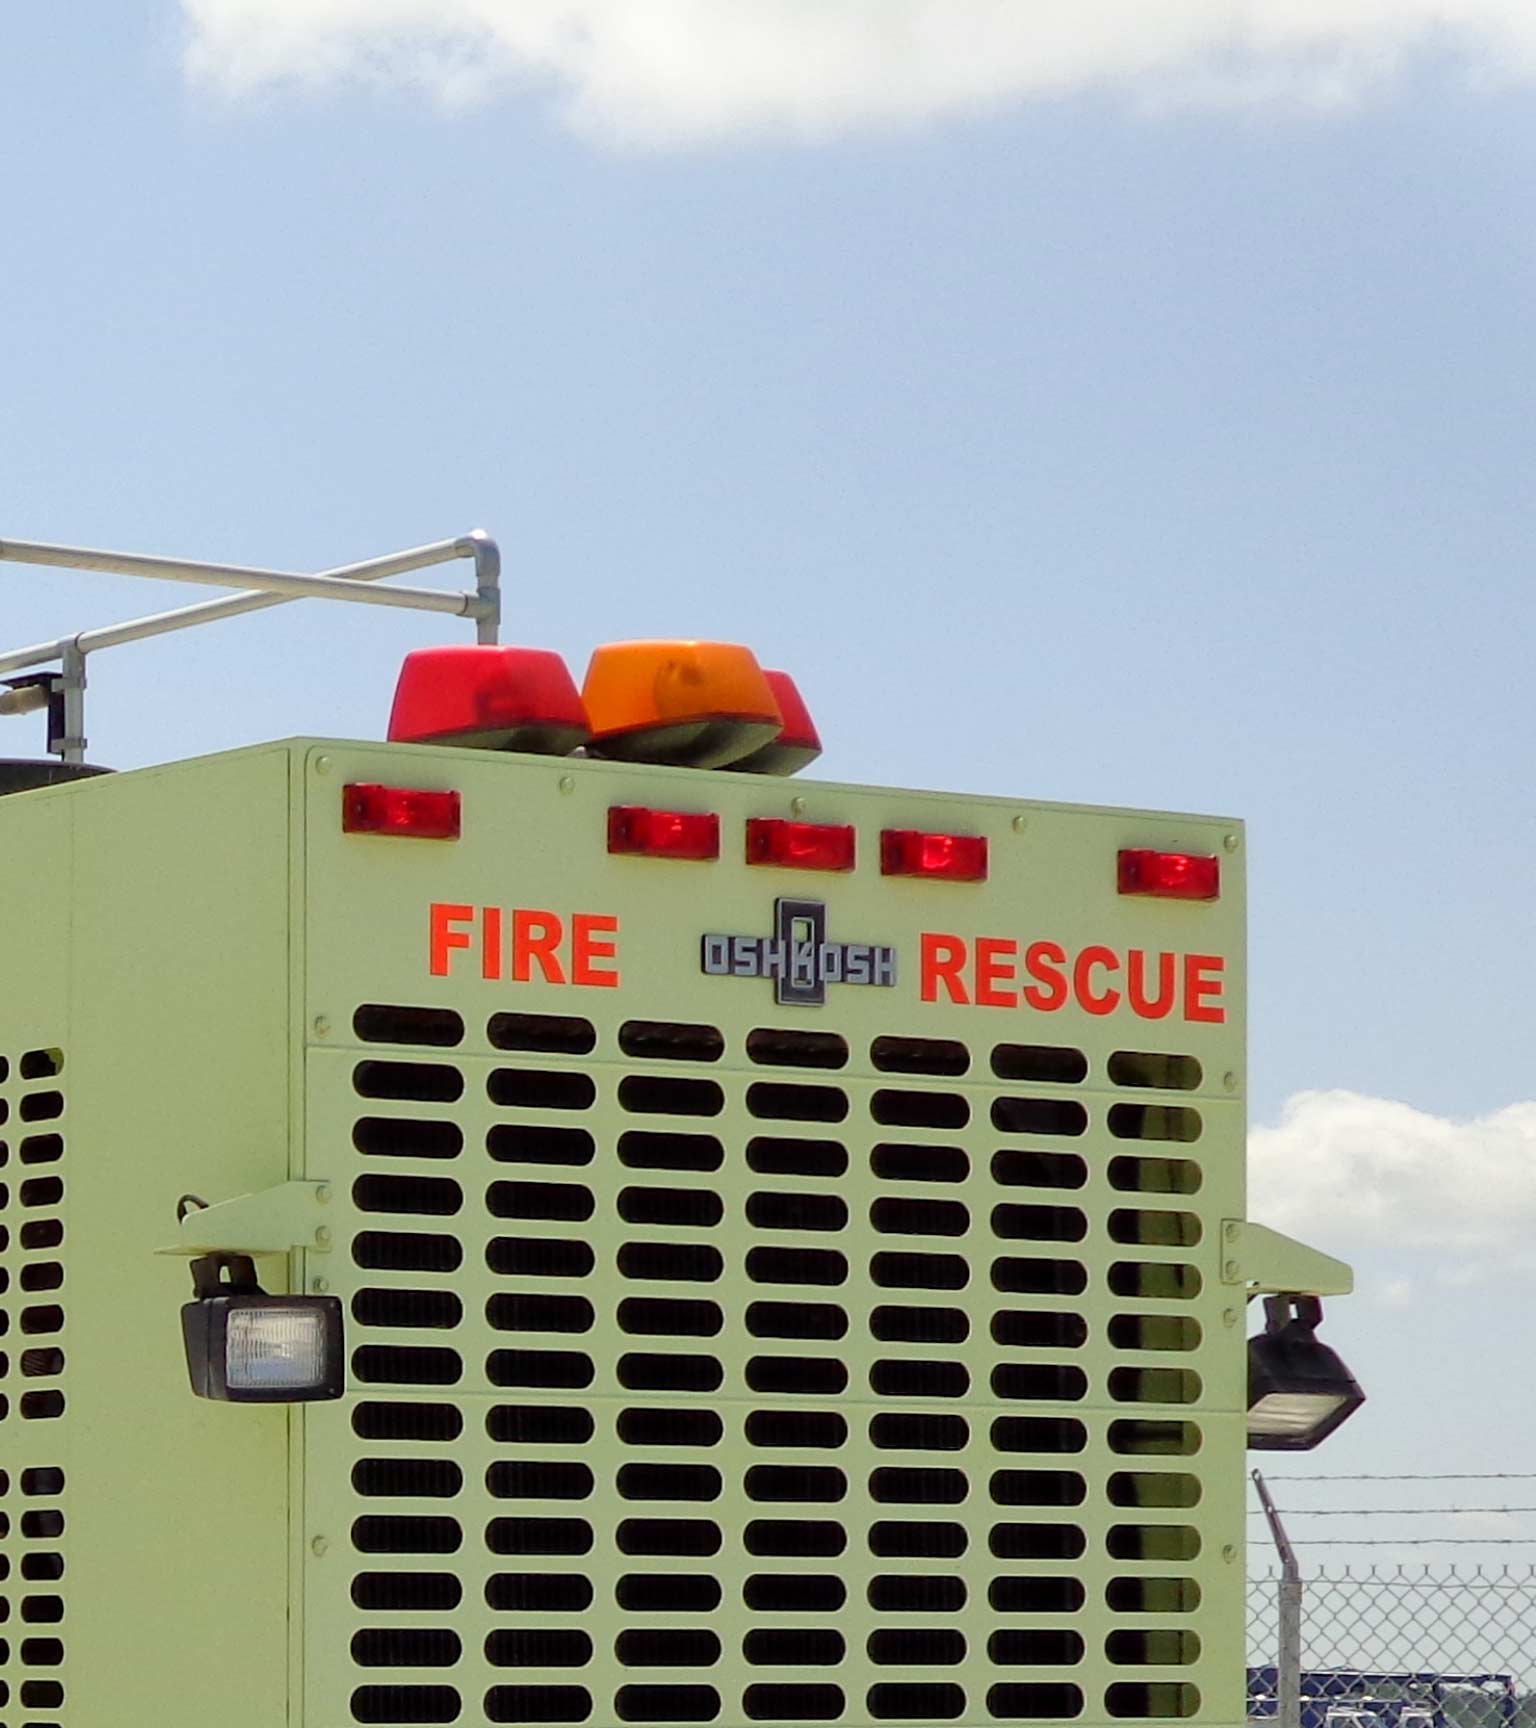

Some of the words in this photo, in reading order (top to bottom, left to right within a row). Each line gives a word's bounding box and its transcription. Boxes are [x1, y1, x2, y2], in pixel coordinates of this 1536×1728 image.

[430, 903, 620, 987] FIRE
[702, 932, 897, 988] OSHKOSH
[920, 932, 1226, 1023] RESCUE
